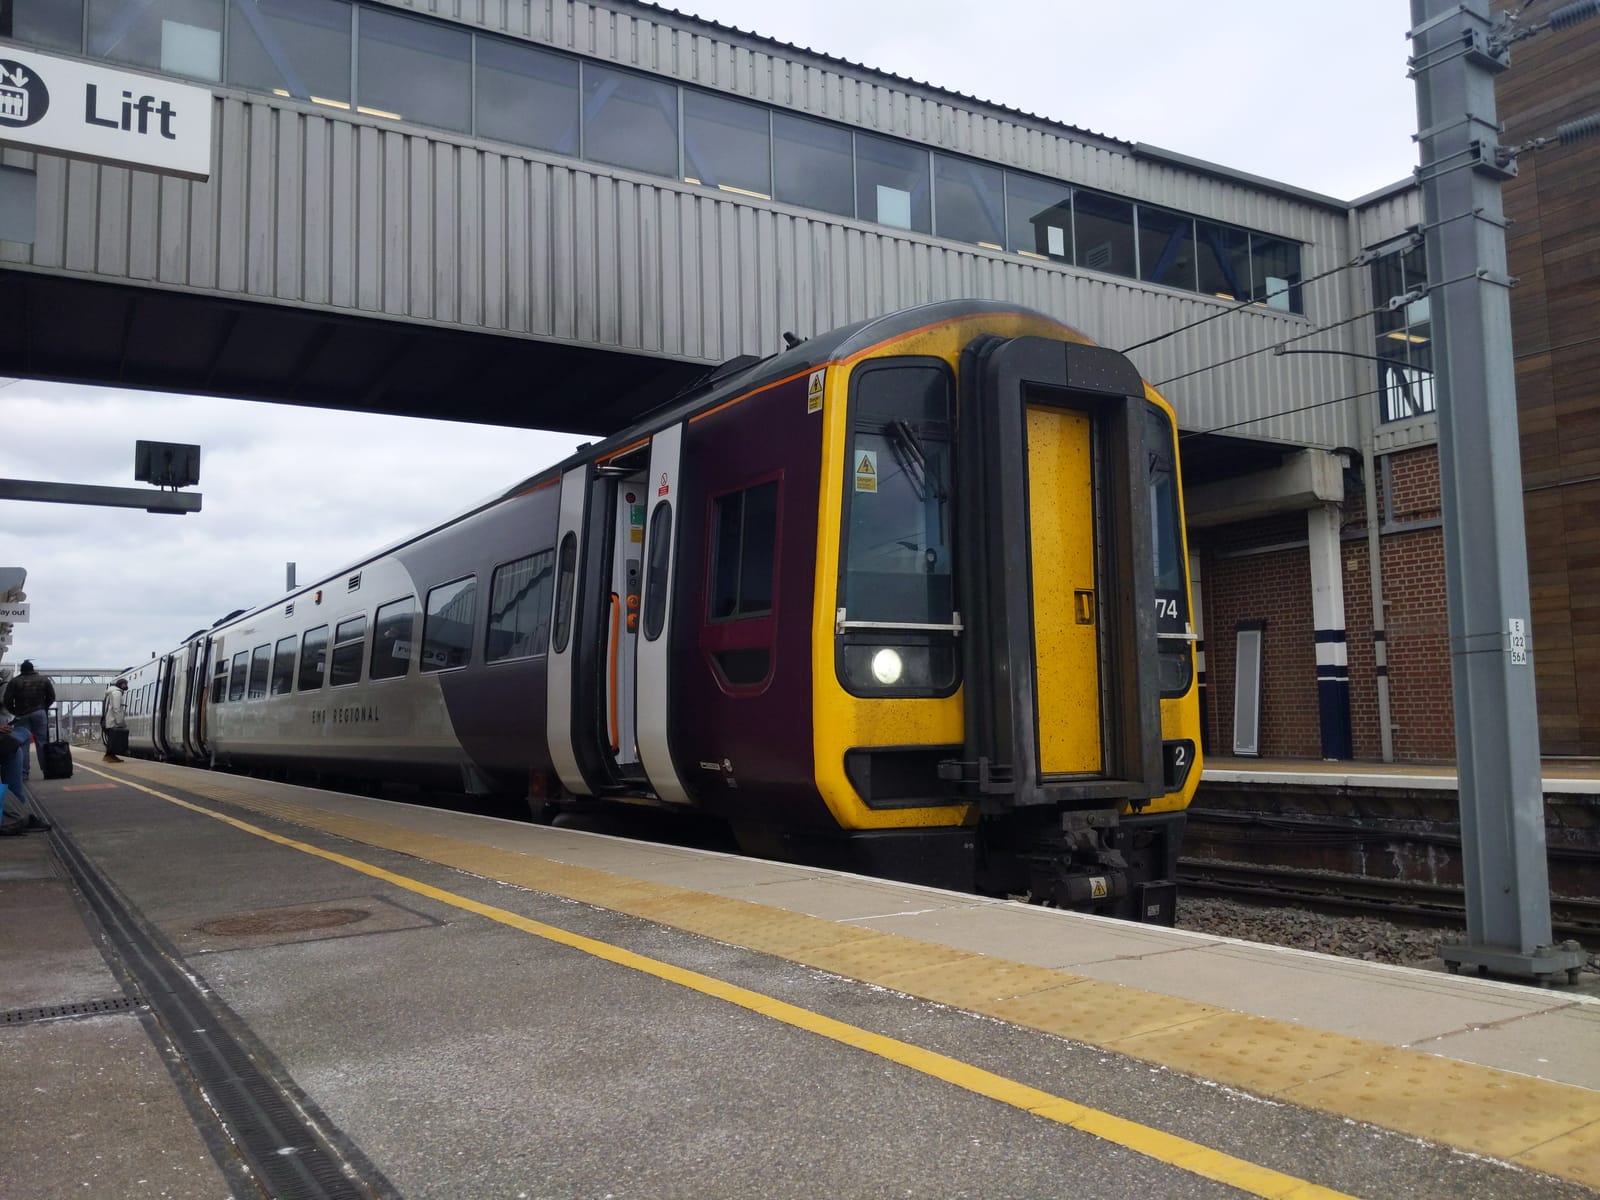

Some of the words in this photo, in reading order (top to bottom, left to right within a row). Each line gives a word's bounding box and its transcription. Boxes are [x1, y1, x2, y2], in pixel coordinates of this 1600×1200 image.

[85, 83, 176, 140] Lift
[0, 609, 10, 617] ay
[1155, 599, 1178, 619] 74
[1515, 621, 1520, 632] E
[1513, 636, 1524, 647] 122
[333, 705, 379, 723] REGIONAL
[1175, 746, 1185, 766] 2
